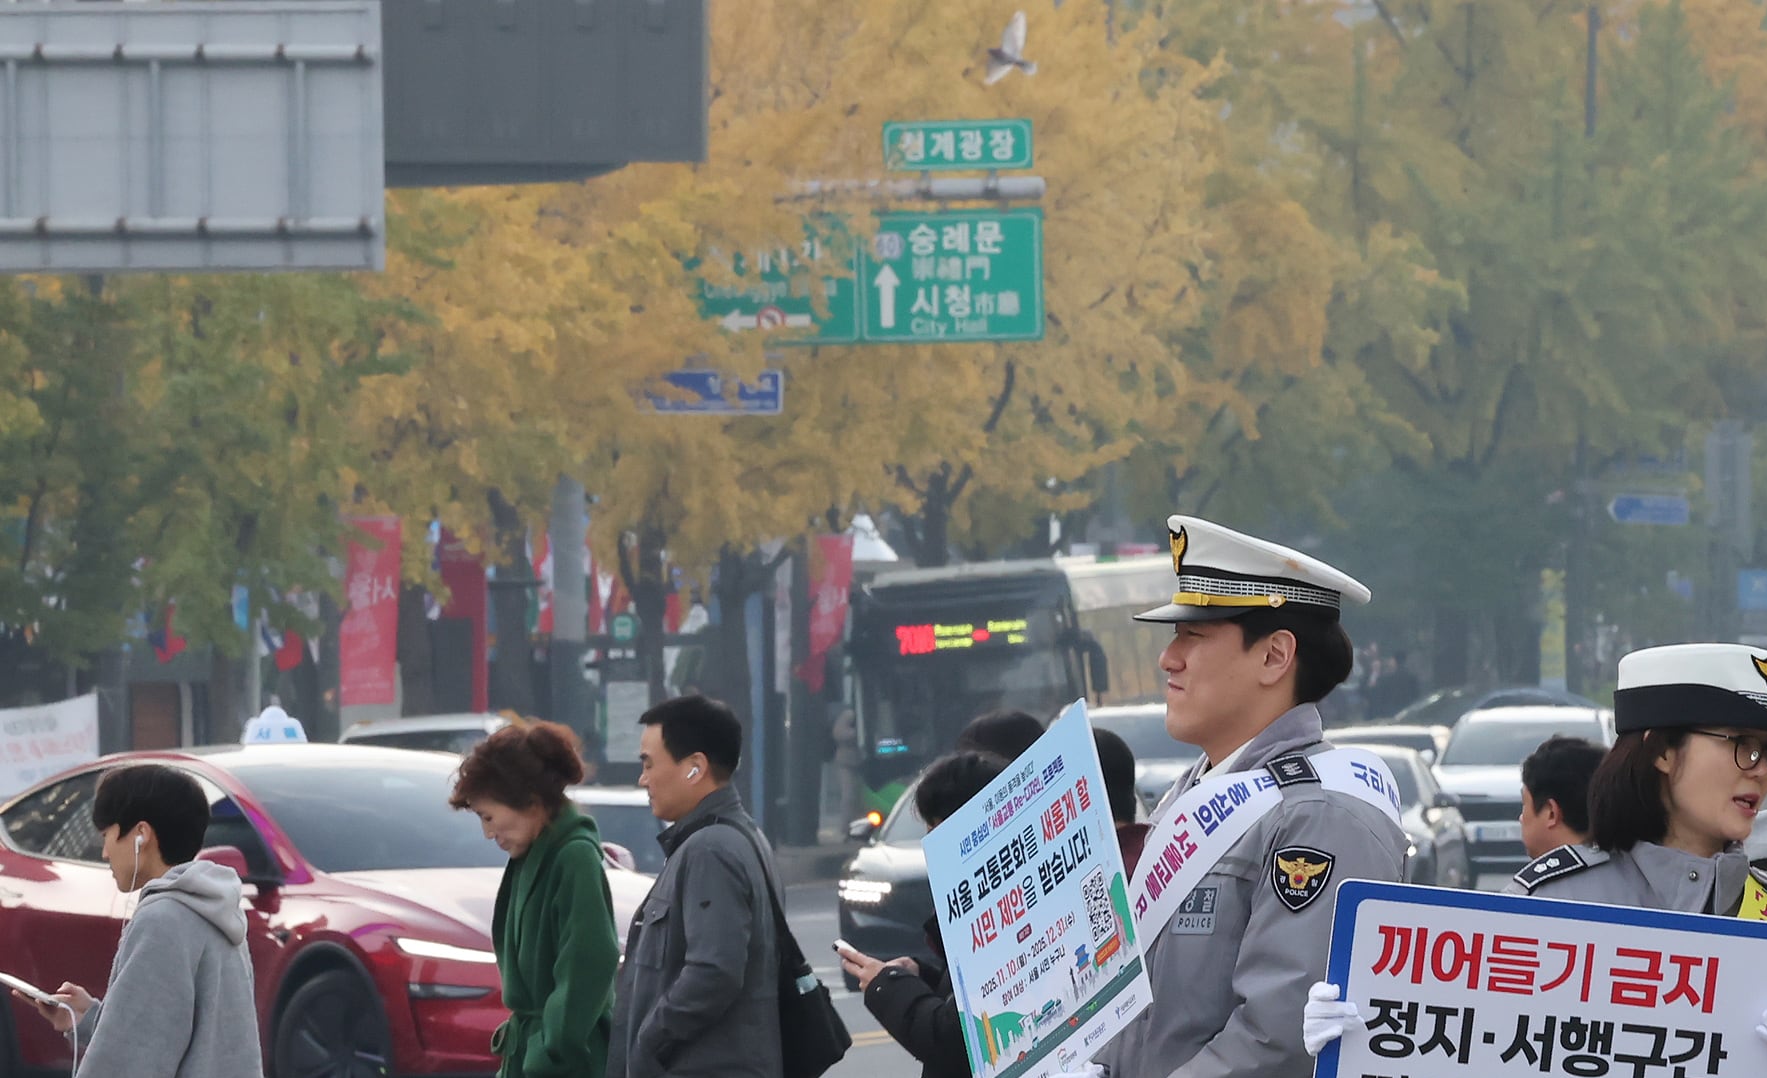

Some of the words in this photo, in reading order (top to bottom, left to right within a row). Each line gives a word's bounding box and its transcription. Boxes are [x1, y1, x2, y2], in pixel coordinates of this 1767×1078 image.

[908, 222, 1004, 254] 숭례문
[911, 285, 971, 317] 시청
[911, 319, 947, 339] City
[955, 317, 989, 334] Hall
[959, 835, 972, 856] 시민
[971, 821, 989, 847] 중심의
[1042, 755, 1063, 785] 프로젝트
[1192, 781, 1250, 837] 중심의
[946, 879, 973, 923] 서울
[974, 825, 1037, 899] 교통문화를
[1040, 788, 1076, 843] 새롭게
[1075, 775, 1090, 811] 할
[970, 907, 997, 952] 시민
[997, 875, 1037, 928] 제안을
[1038, 826, 1090, 894] 받습니다!
[1135, 894, 1148, 923] R
[1285, 888, 1308, 897] POLICE
[1178, 917, 1212, 929] POLICE
[1001, 988, 1013, 1006] 참여
[1012, 979, 1024, 997] 대상
[1028, 966, 1039, 983] 서울
[1039, 957, 1050, 974] 시민
[1049, 944, 1065, 964] 누구나
[1371, 924, 1595, 1002] 끼어들기
[1609, 946, 1720, 1013] 금지
